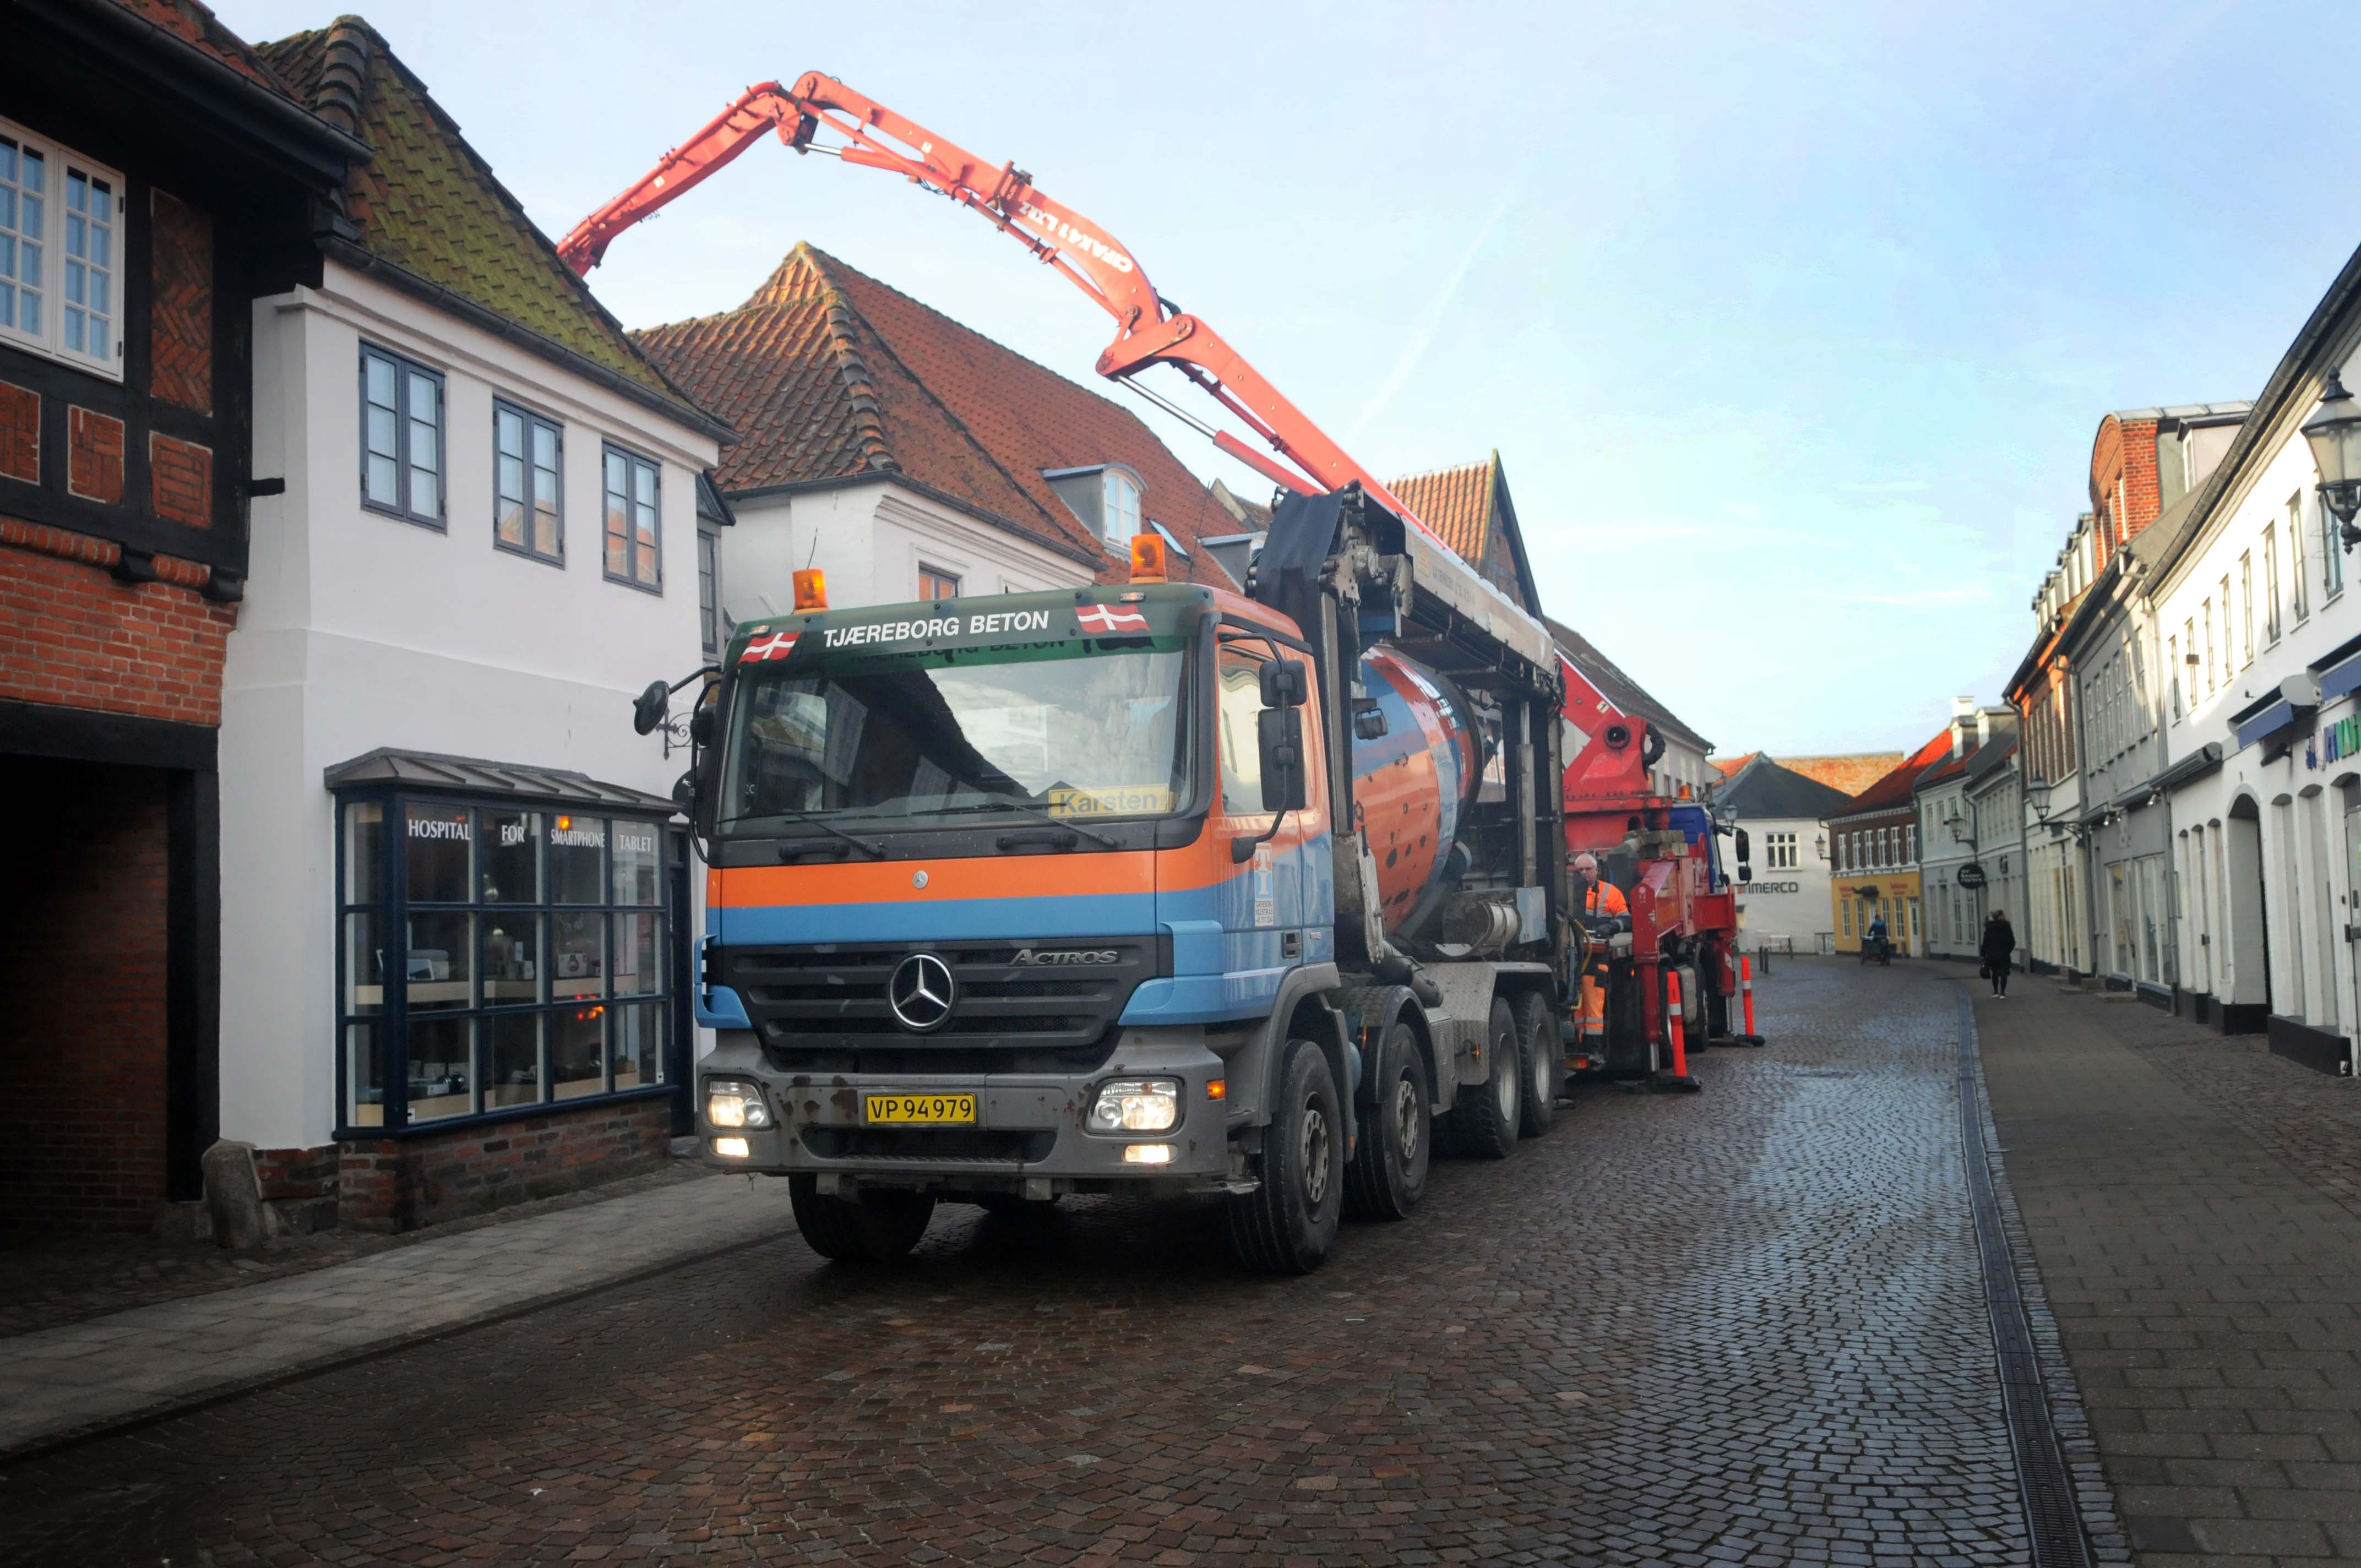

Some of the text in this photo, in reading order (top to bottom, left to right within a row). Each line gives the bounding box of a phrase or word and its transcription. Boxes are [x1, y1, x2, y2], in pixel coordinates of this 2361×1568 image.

[824, 611, 1049, 647] TJÆREBORG BETON
[1059, 791, 1156, 814] Karsten
[408, 820, 652, 852] HOSPITAL FOR SMARTPHONE TABLET
[1009, 949, 1118, 966] ACTROS
[871, 1099, 898, 1118] VP
